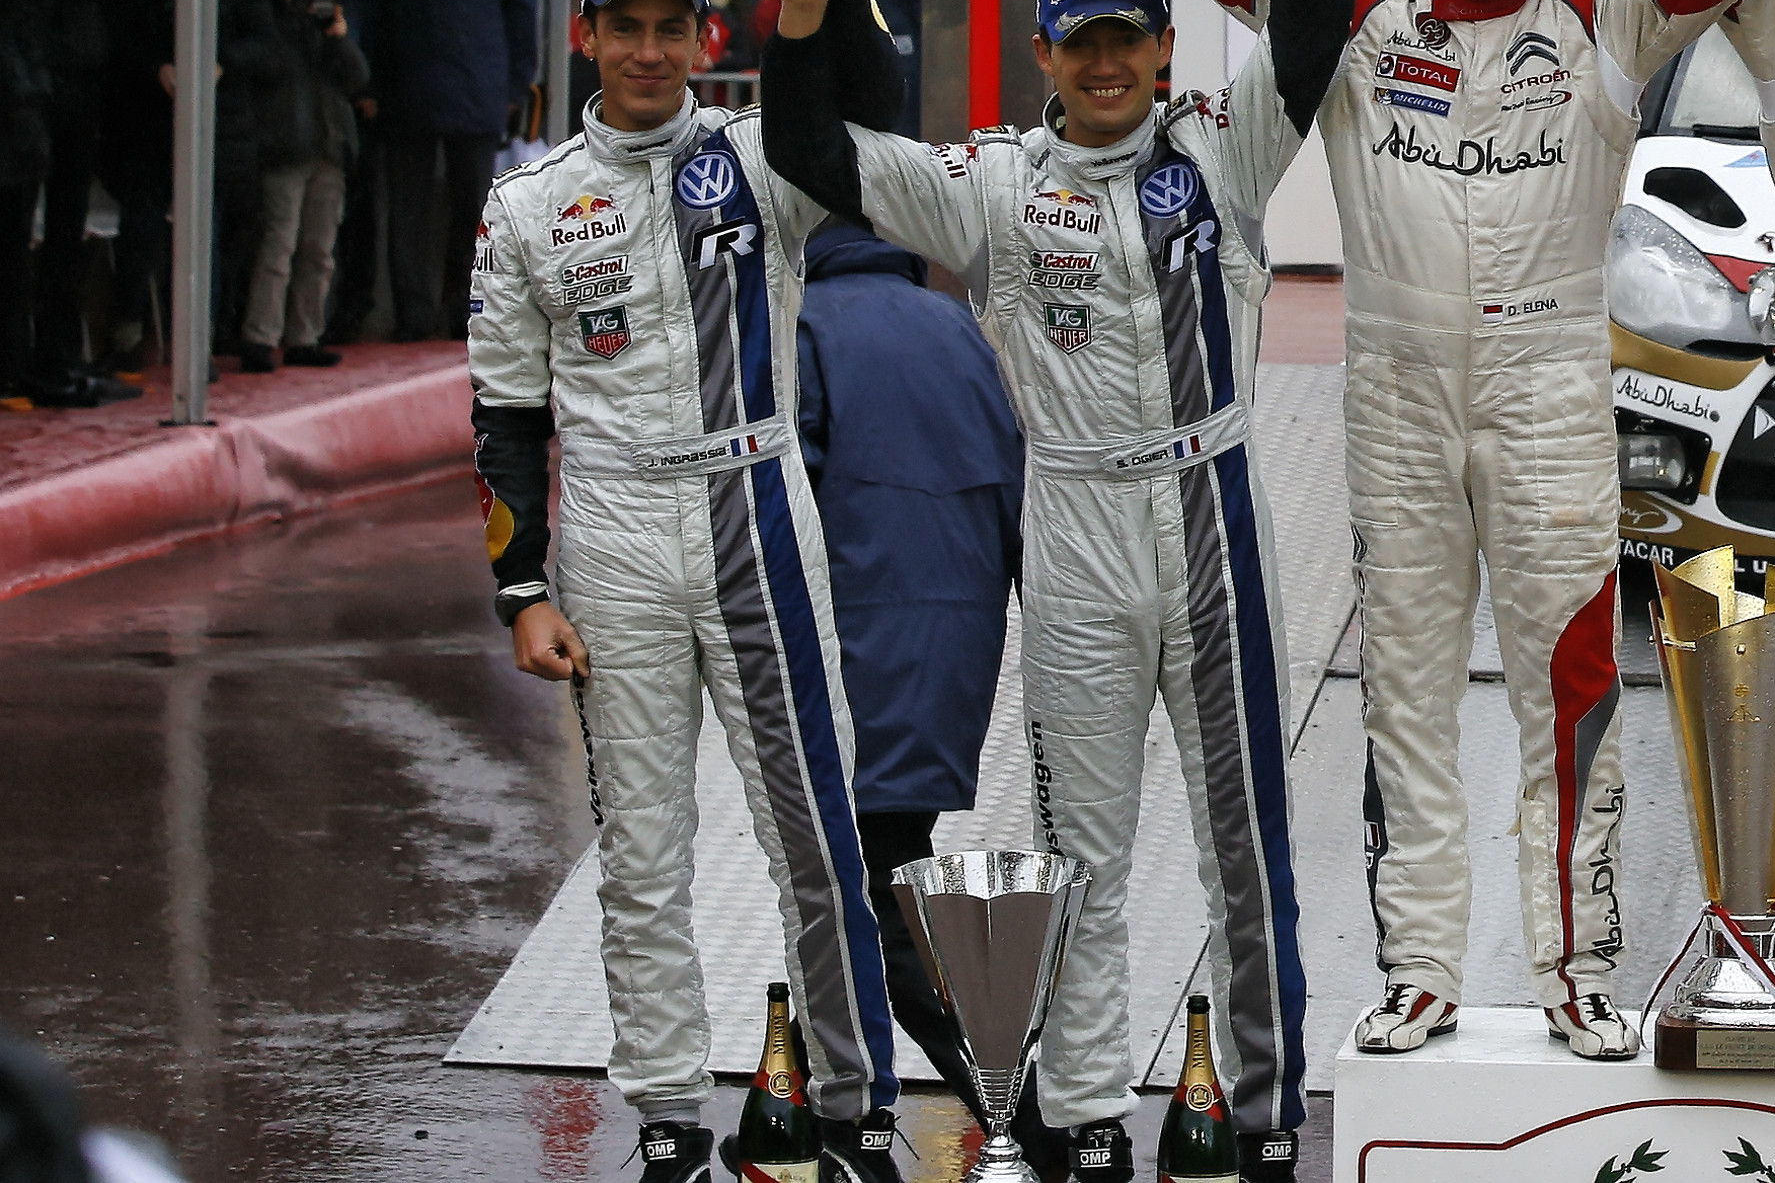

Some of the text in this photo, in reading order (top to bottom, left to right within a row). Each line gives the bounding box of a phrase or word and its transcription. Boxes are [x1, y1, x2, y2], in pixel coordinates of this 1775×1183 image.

[1399, 61, 1453, 86] TOTAL
[1394, 92, 1449, 112] MICHELIN
[1373, 121, 1567, 175] Abu Dhabi
[552, 213, 627, 247] Red Bull
[1024, 204, 1100, 235] Red Bull
[576, 256, 624, 281] Castrol
[1043, 252, 1094, 270] Castrol
[562, 274, 633, 306] EDGE
[1029, 270, 1100, 290] EDGE
[1508, 298, 1559, 317] D. ELENA
[588, 332, 629, 355] HEUER
[1050, 328, 1088, 350] HEUER
[1617, 374, 1712, 420] Abu Dhabi
[1132, 450, 1169, 466] OGIER
[1031, 720, 1067, 855] swagen
[772, 1014, 786, 1056] MUMM
[1191, 1028, 1206, 1069] MUMM
[646, 1142, 676, 1157] OMP
[862, 1134, 891, 1147] OMP
[1262, 1145, 1292, 1157] OMP
[1080, 1152, 1111, 1164] OMP
